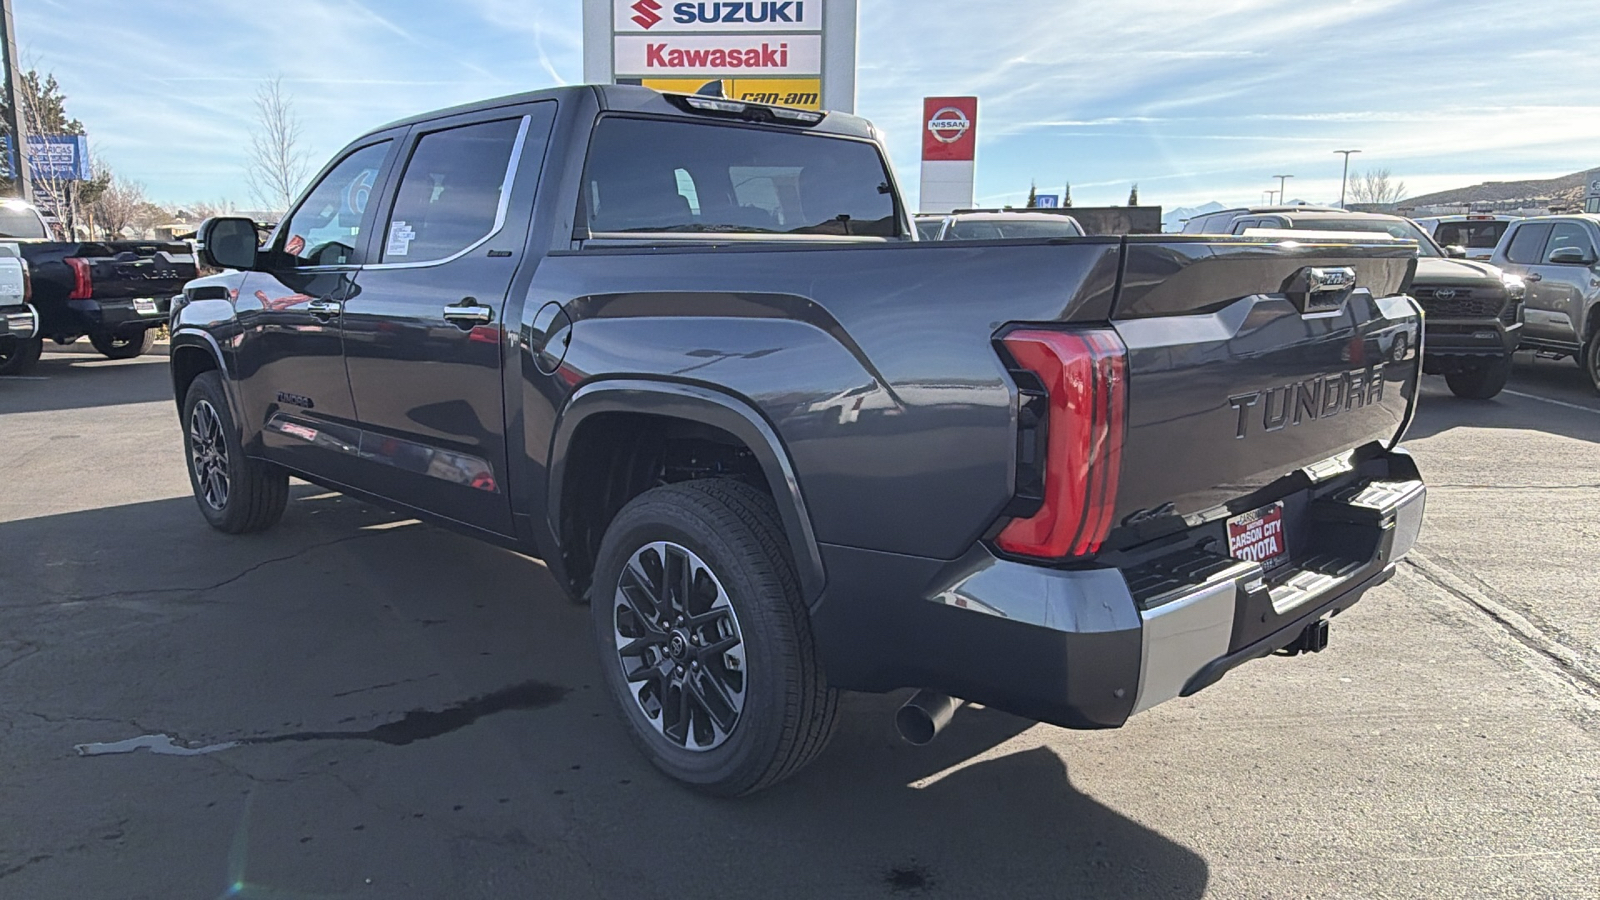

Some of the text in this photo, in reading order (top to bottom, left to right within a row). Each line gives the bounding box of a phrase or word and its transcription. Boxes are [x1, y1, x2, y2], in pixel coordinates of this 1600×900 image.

[673, 1, 803, 24] SUZUKI
[646, 43, 788, 68] Kawasaki
[741, 92, 818, 105] can-am
[1228, 361, 1390, 440] TUNDRA
[1231, 519, 1282, 551] CARSON CITY
[1236, 536, 1278, 561] TOYOTA
